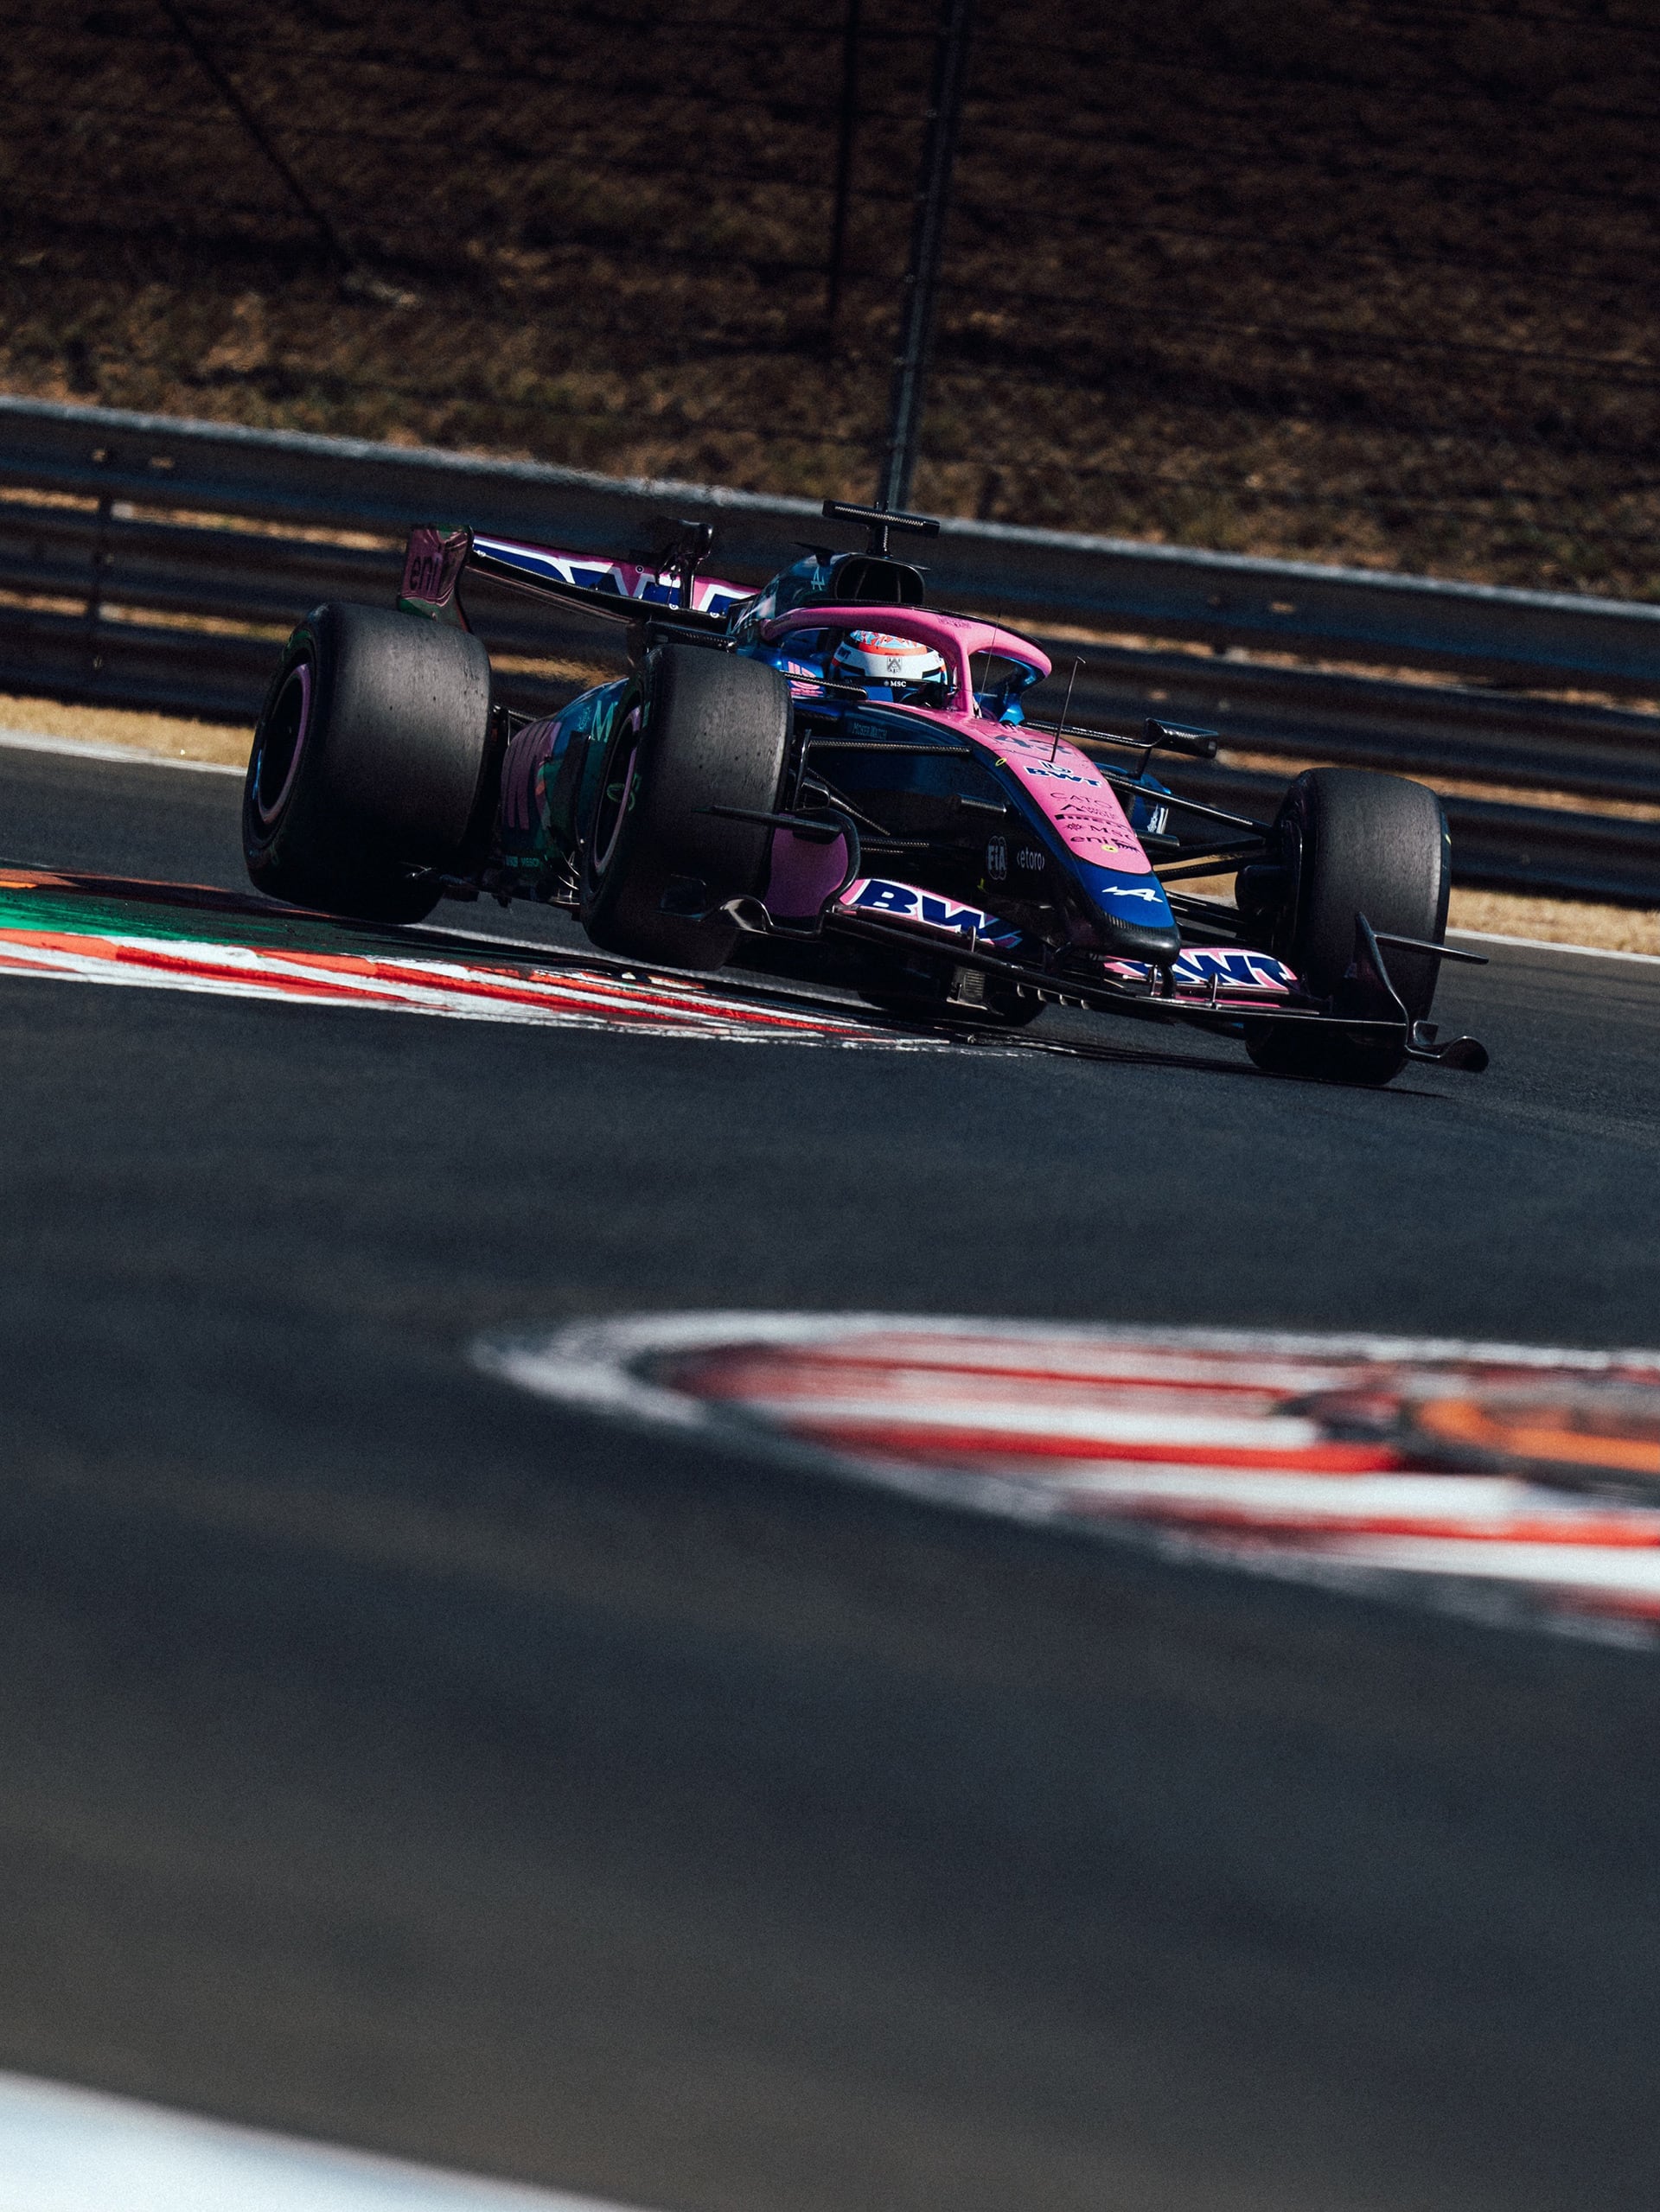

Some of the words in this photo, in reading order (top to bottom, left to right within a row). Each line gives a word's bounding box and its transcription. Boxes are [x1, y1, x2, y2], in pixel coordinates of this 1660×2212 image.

[1024, 766, 1101, 787] BWT
[1070, 836, 1109, 845] eni
[988, 845, 1006, 871] FIA
[854, 878, 1022, 946] BW
